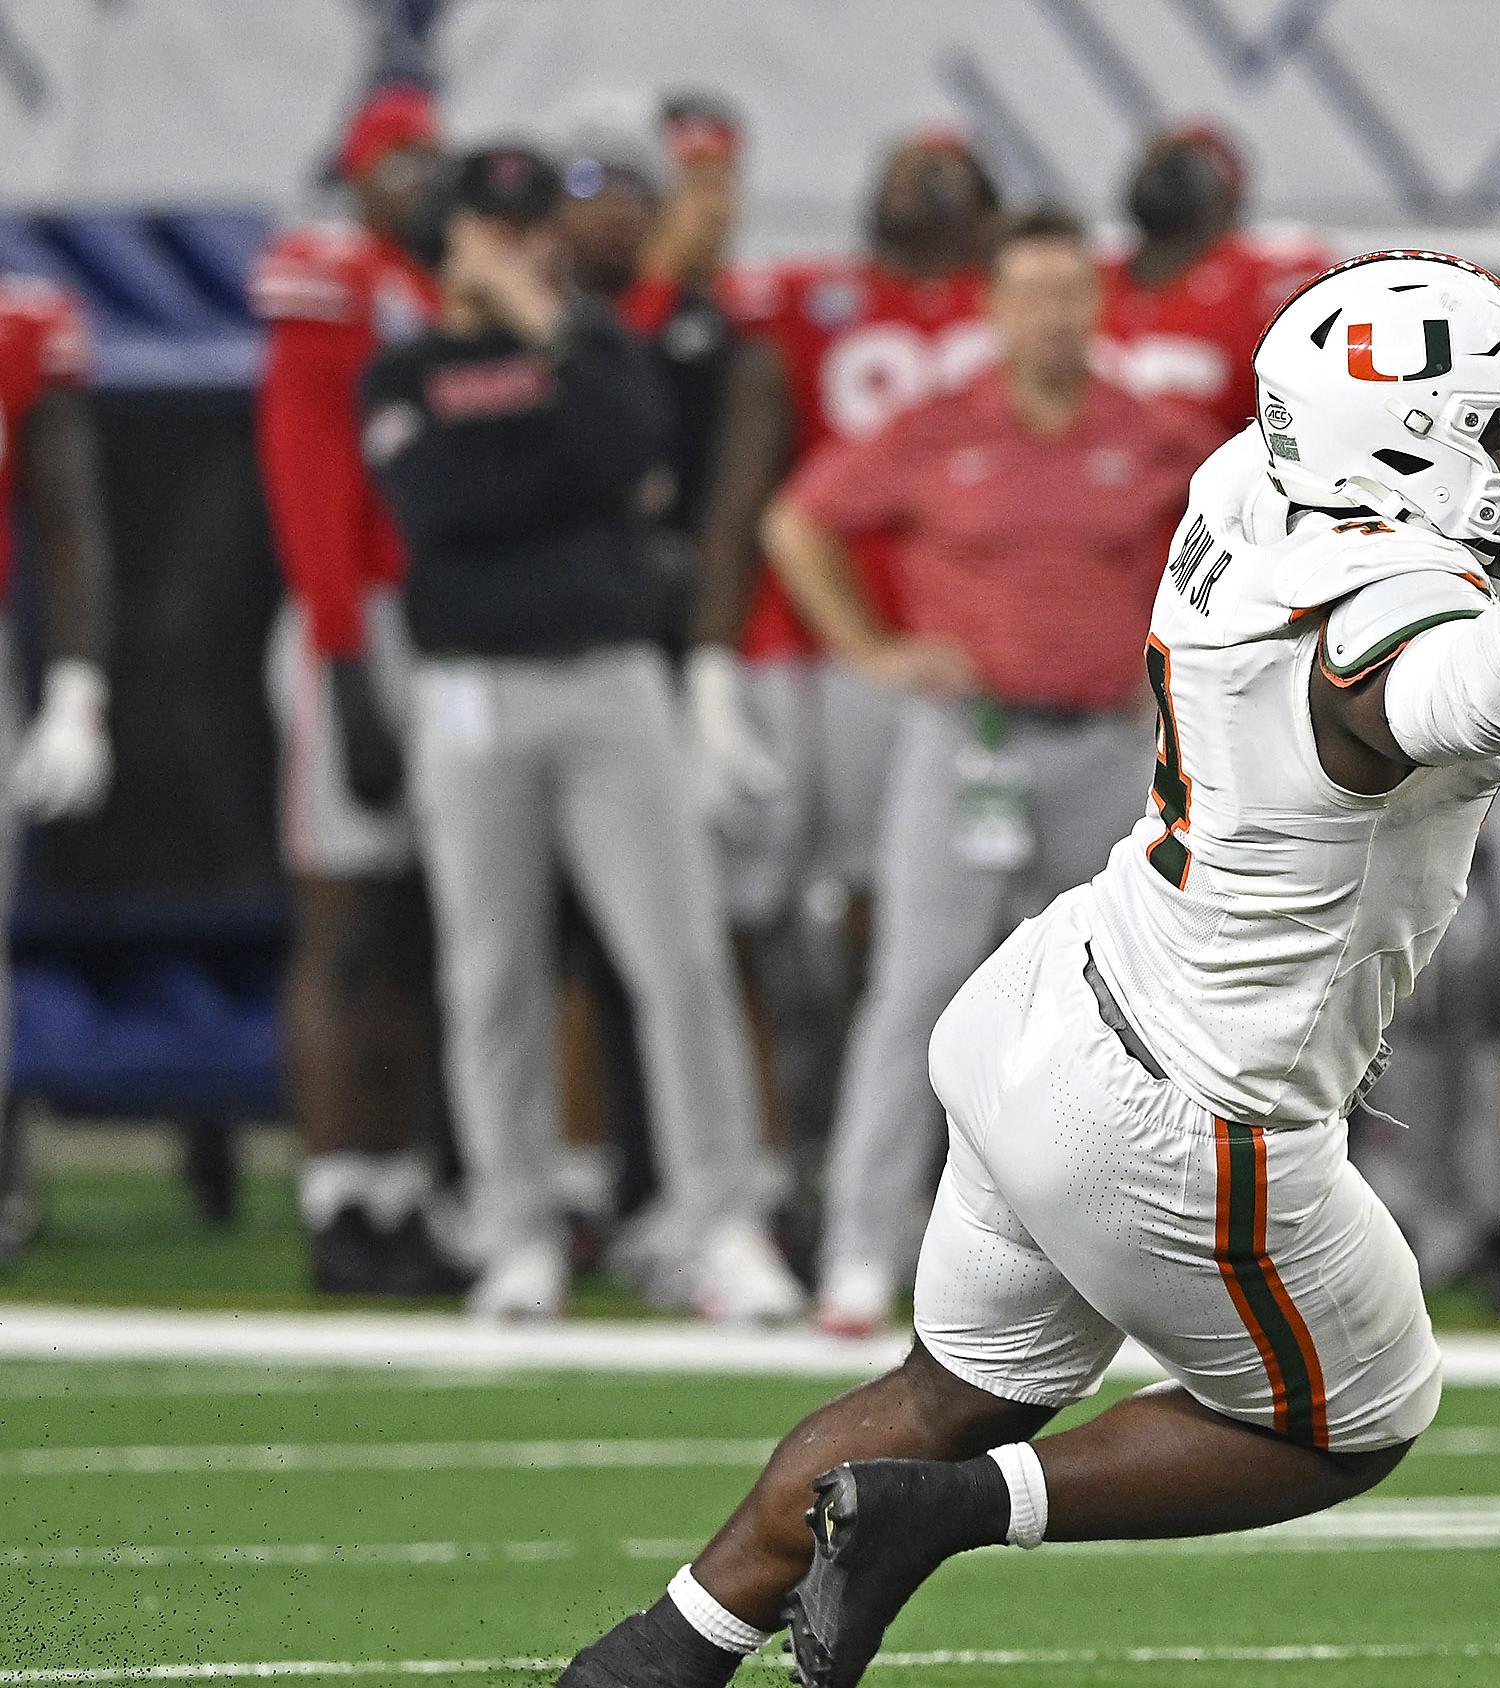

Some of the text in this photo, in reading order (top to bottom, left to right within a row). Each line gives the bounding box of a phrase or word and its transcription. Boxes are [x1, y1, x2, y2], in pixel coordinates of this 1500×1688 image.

[1347, 319, 1453, 383] U
[1267, 409, 1288, 421] ACC
[1169, 513, 1214, 596] BAIN
